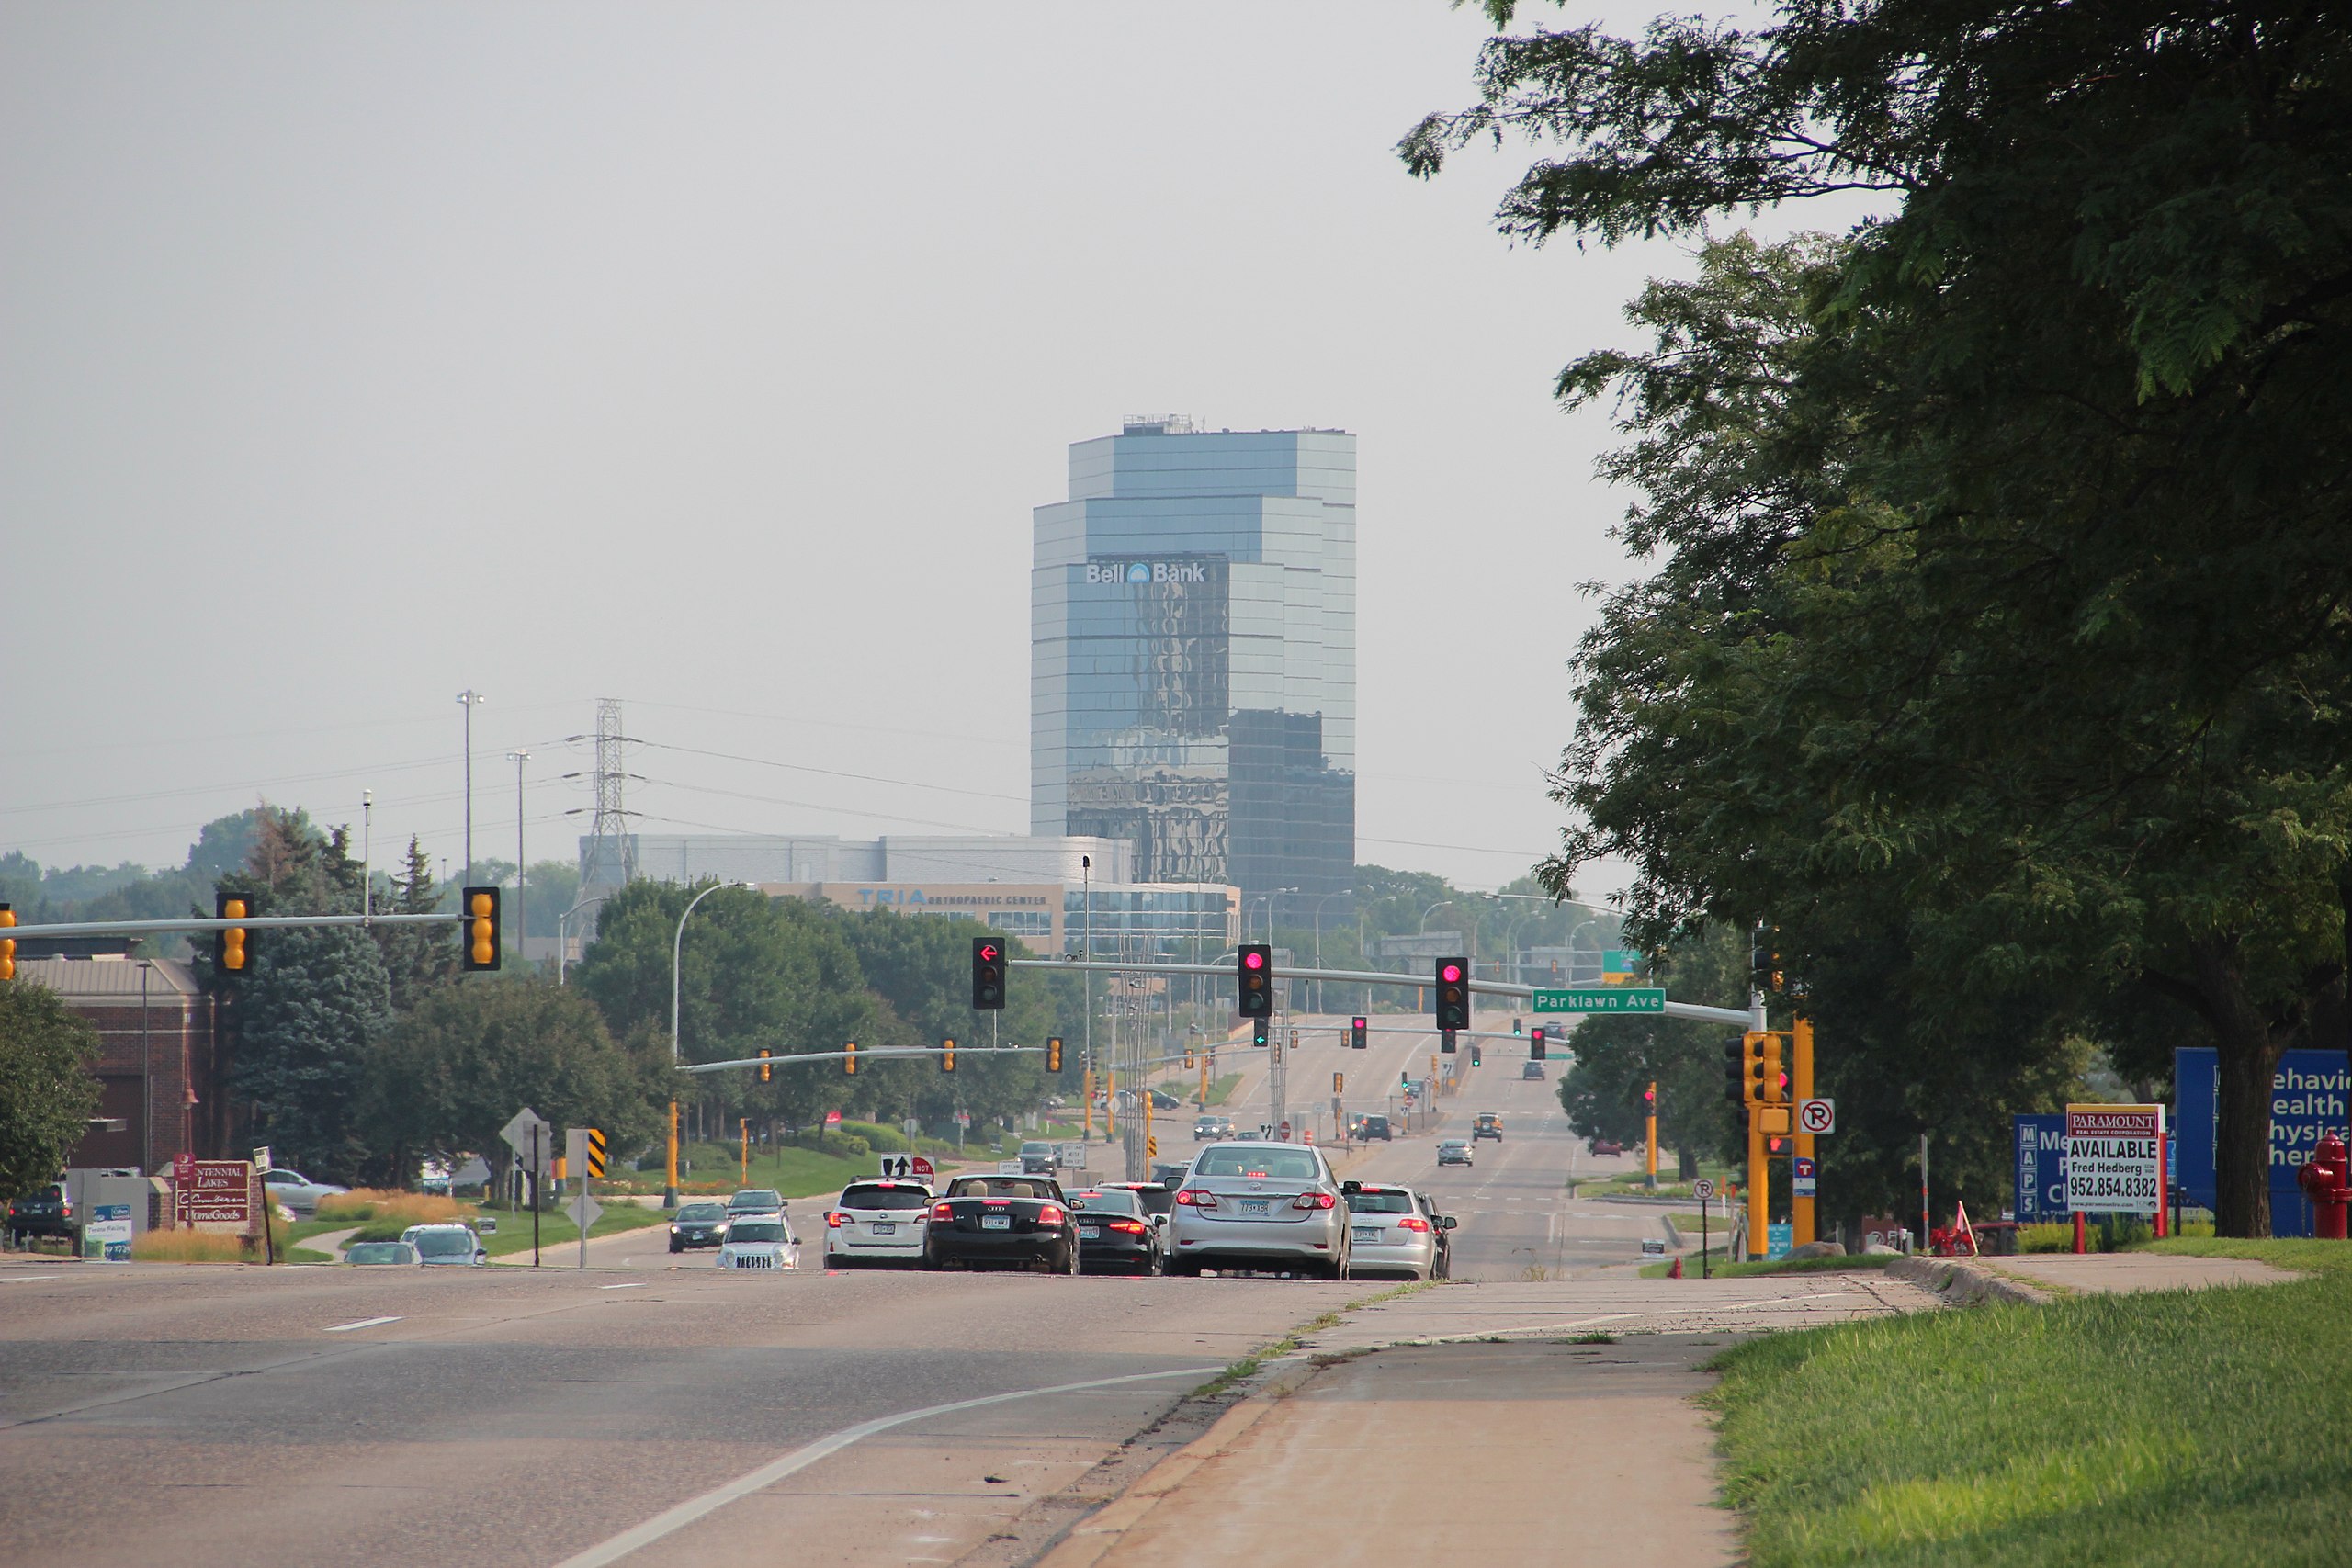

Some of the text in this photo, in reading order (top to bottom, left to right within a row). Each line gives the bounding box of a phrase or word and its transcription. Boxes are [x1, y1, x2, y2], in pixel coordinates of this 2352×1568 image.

[1086, 562, 1205, 583] Bell Bank
[858, 888, 1046, 905] TRIA ORTHOPAEDIC CENTER
[1537, 994, 1659, 1008] Parklawn Ave
[2273, 1067, 2351, 1090] ehavi
[2272, 1093, 2344, 1116] ealth
[2072, 1115, 2155, 1128] PARAMOUNT
[2070, 1140, 2157, 1159] AVAILABLE
[2268, 1144, 2315, 1166] her
[194, 1168, 243, 1177] NTENNIAL
[916, 1165, 930, 1173] NOT
[2072, 1162, 2142, 1176] Fred Hedberg
[198, 1177, 229, 1188] LAKES
[2070, 1177, 2157, 1197] 952.854.8382
